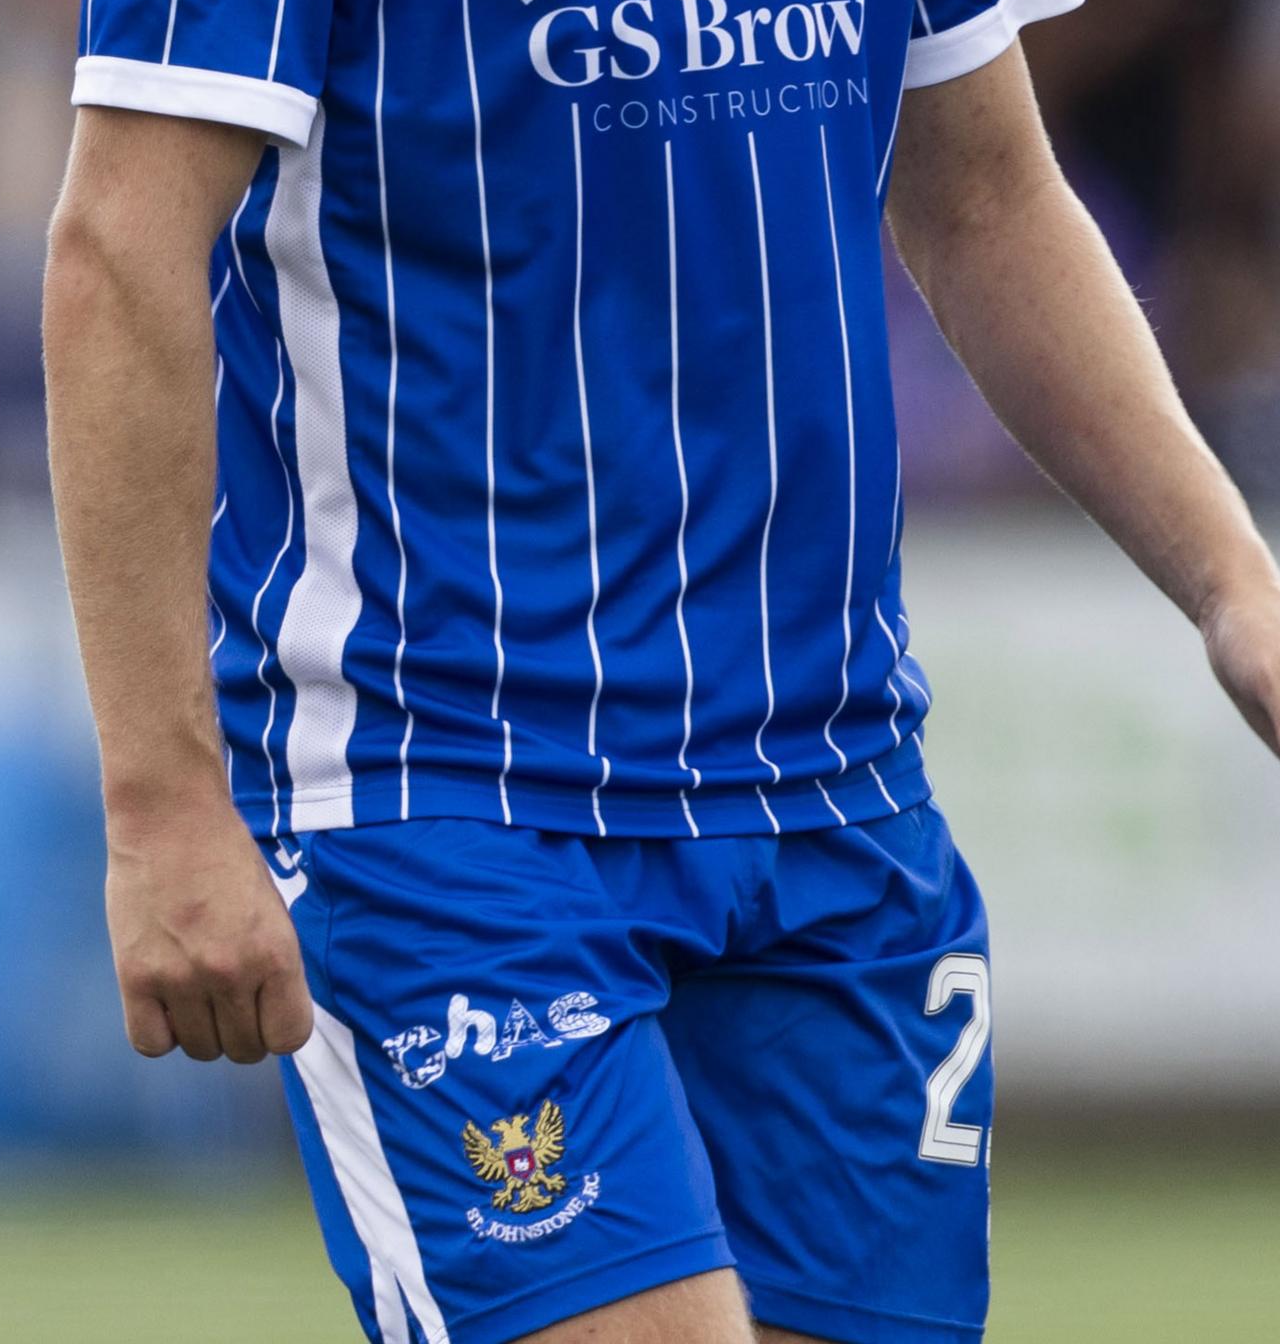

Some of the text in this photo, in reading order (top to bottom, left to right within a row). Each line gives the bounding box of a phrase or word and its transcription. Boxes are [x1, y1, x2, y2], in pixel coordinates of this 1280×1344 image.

[528, 0, 661, 87] GS
[593, 77, 868, 132] CONSTRUCTION
[485, 1197, 587, 1242] JOHNSTONE
